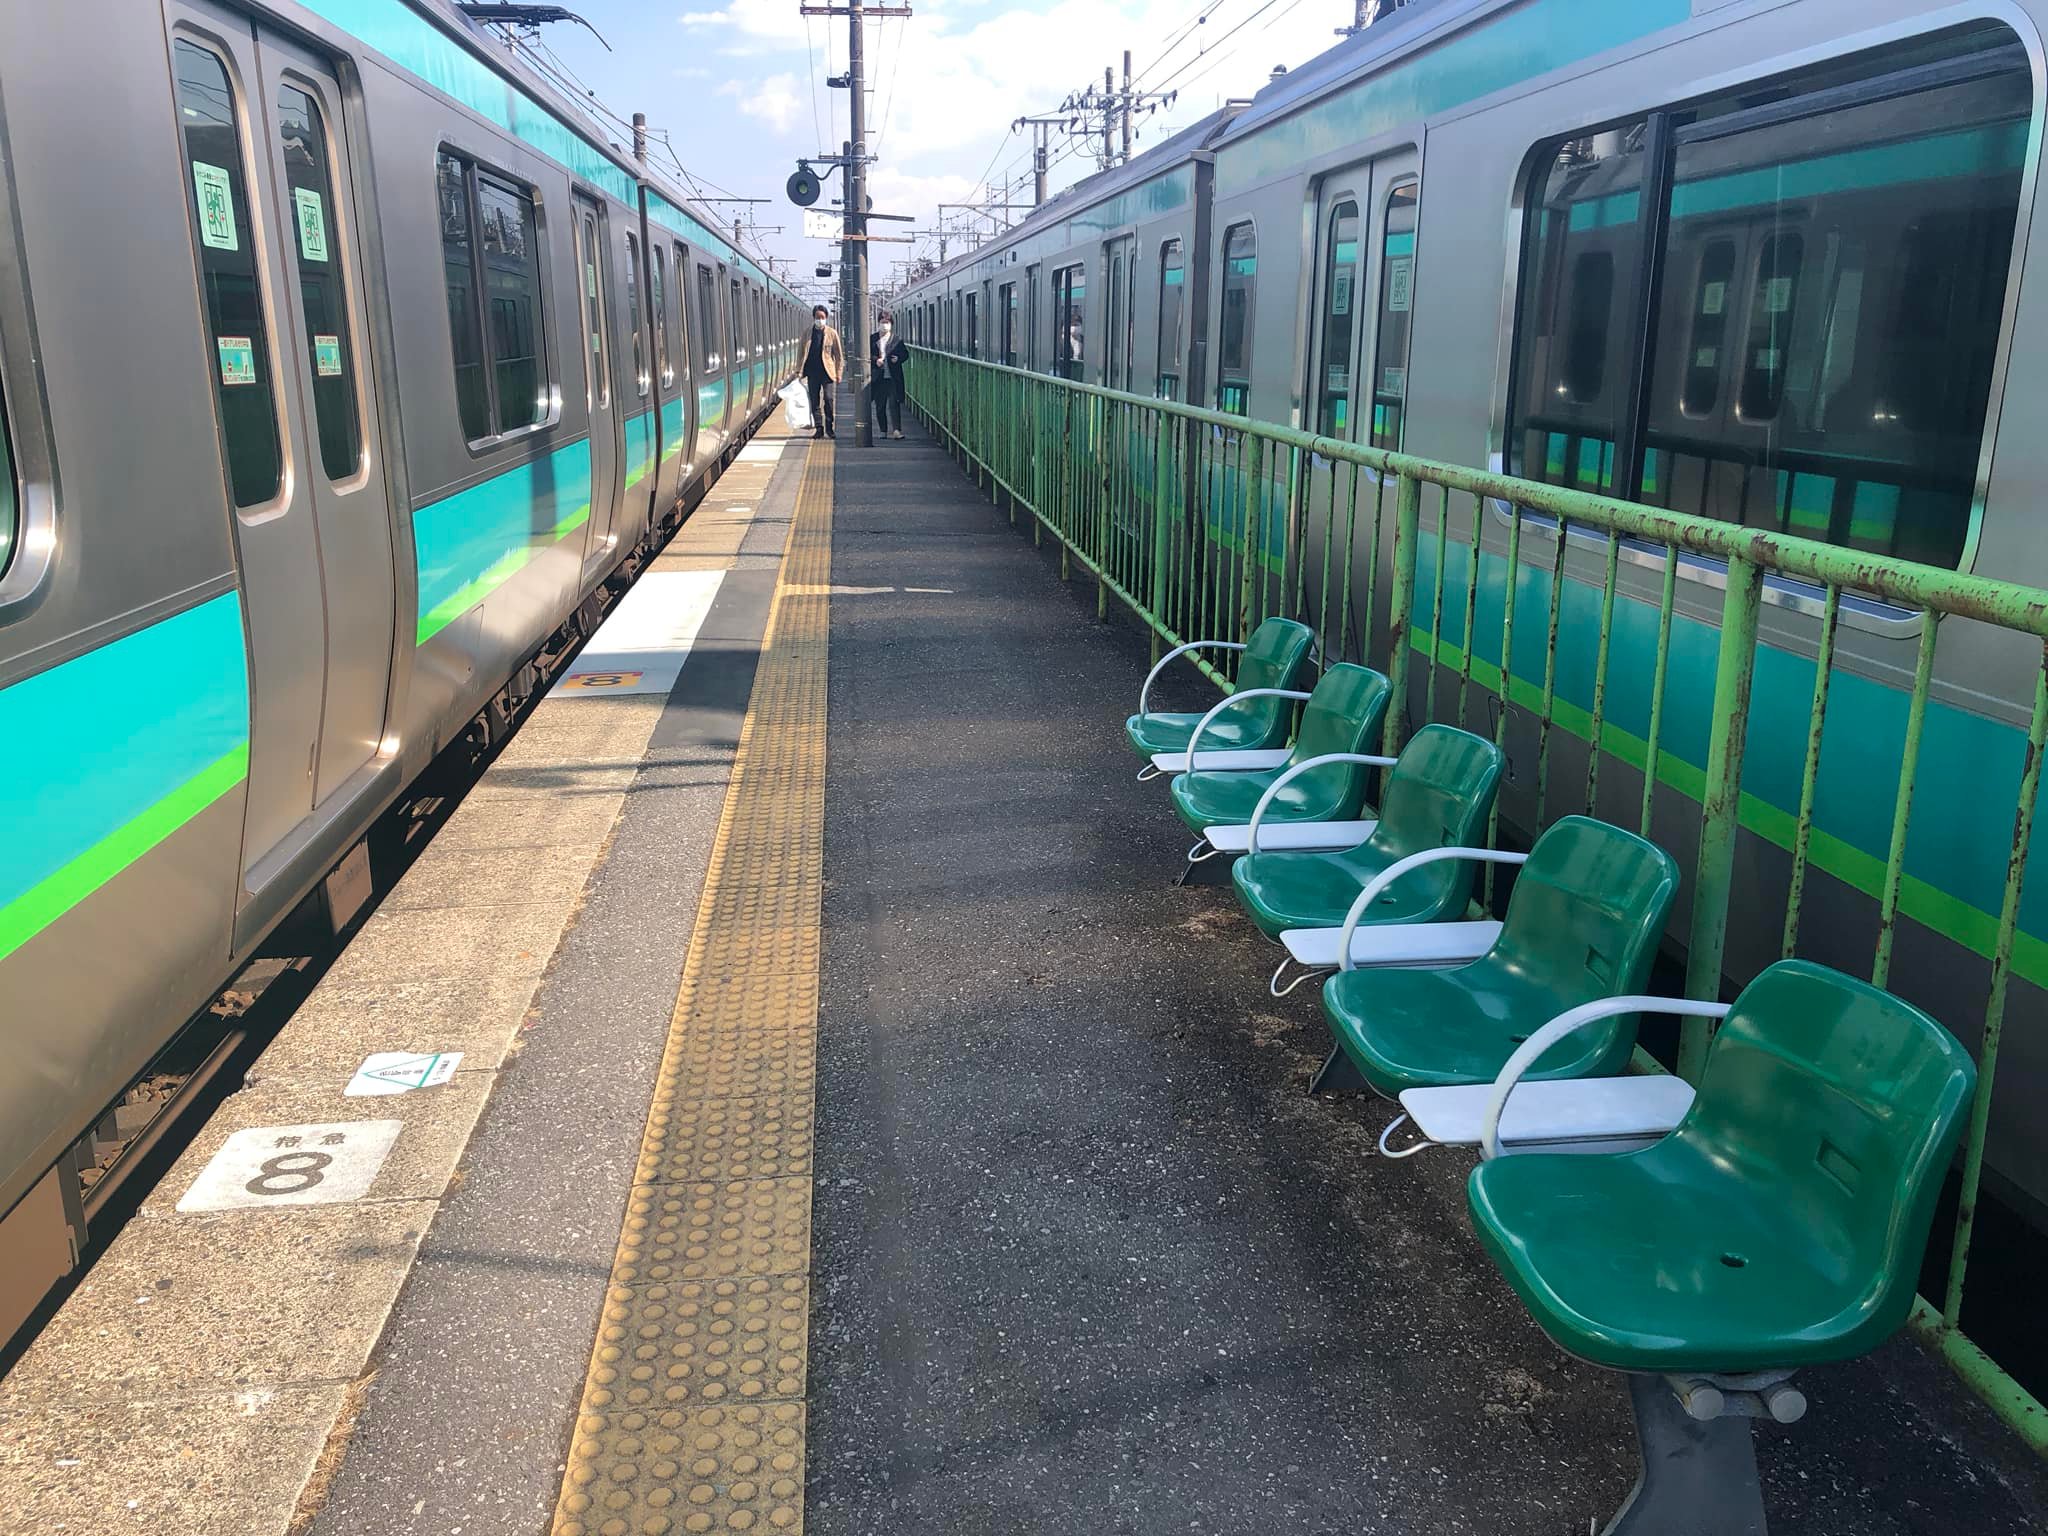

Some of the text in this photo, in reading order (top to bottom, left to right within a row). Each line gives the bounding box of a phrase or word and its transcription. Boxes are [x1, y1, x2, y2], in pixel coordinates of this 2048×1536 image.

[581, 675, 623, 687] 8
[273, 1132, 346, 1148] 特急
[245, 1151, 333, 1196] 8
